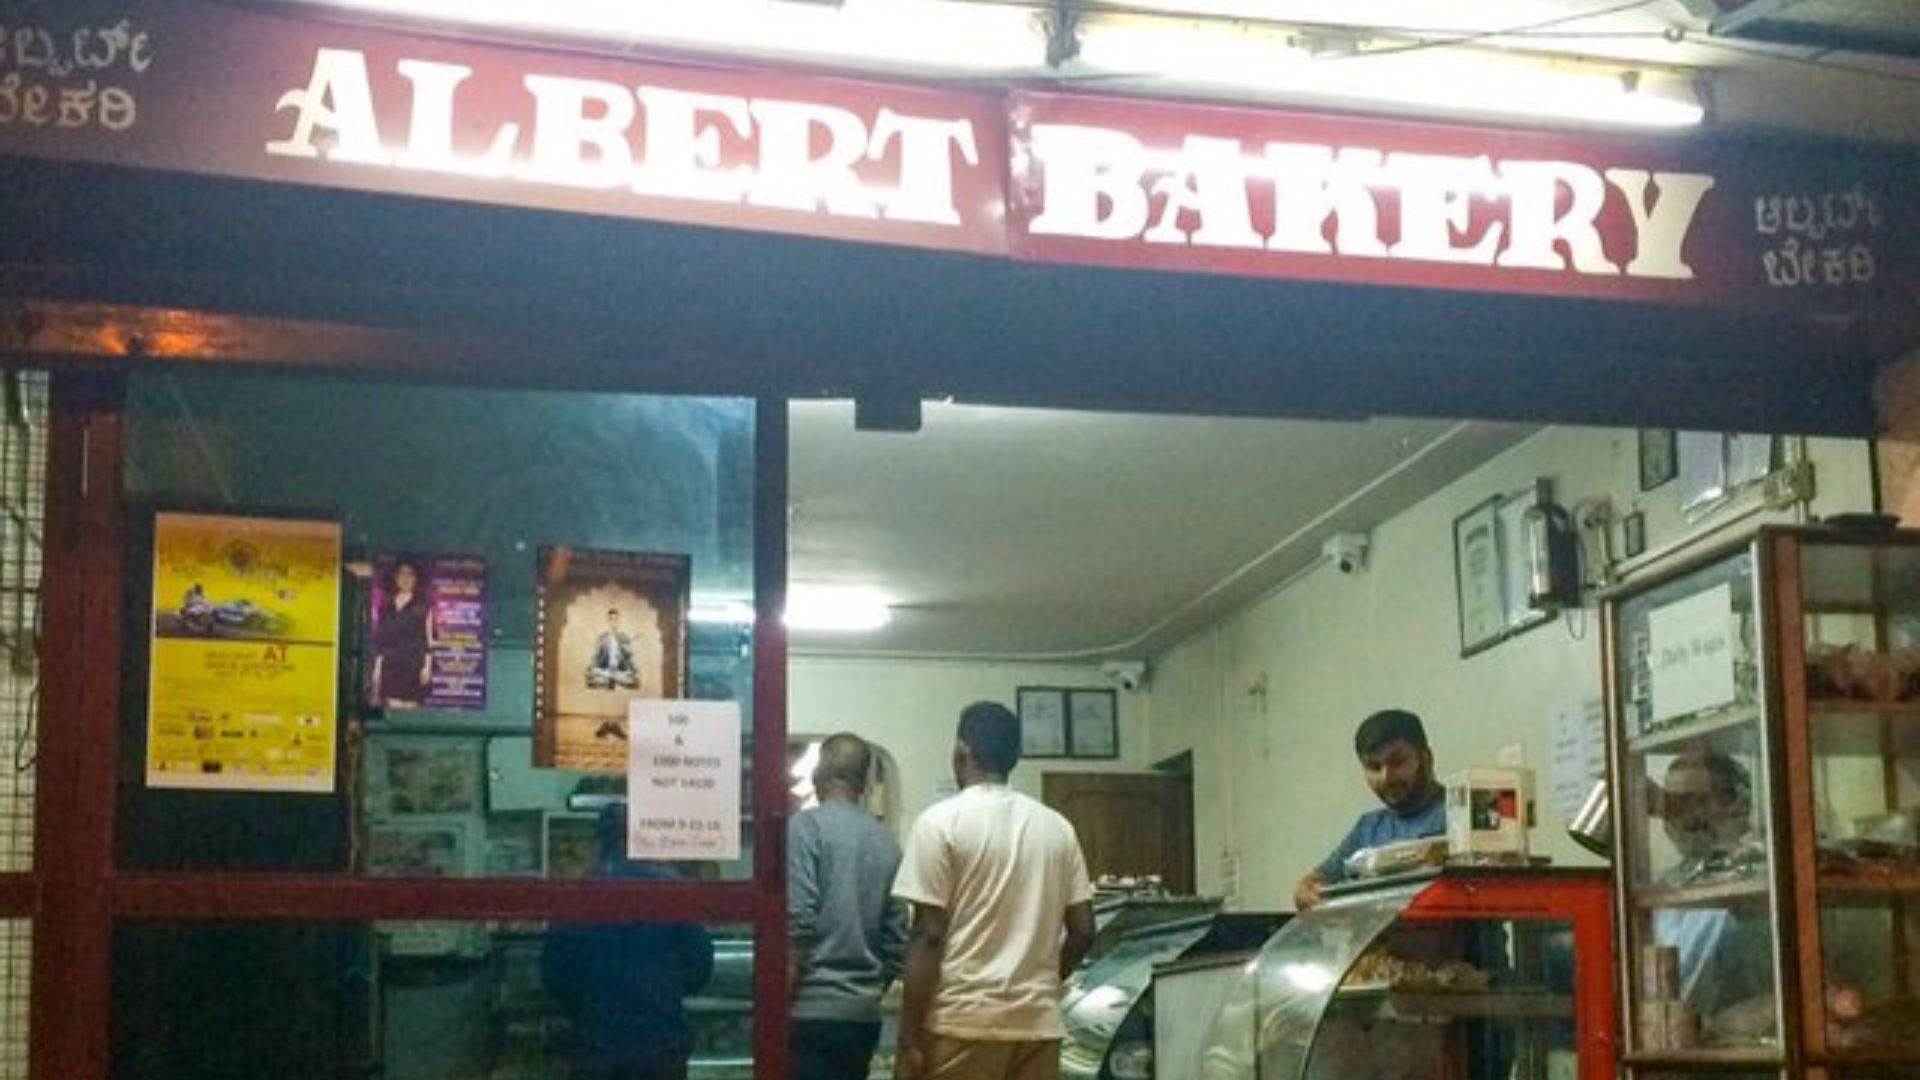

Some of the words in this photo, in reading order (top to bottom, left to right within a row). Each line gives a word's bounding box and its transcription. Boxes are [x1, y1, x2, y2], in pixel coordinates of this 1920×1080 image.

[265, 46, 980, 226] ALBERT
[1028, 123, 1714, 280] BAKERY
[683, 755, 721, 769] NOTES
[652, 777, 678, 789] NOT
[681, 777, 715, 789] VALID
[639, 817, 675, 831] FROM
